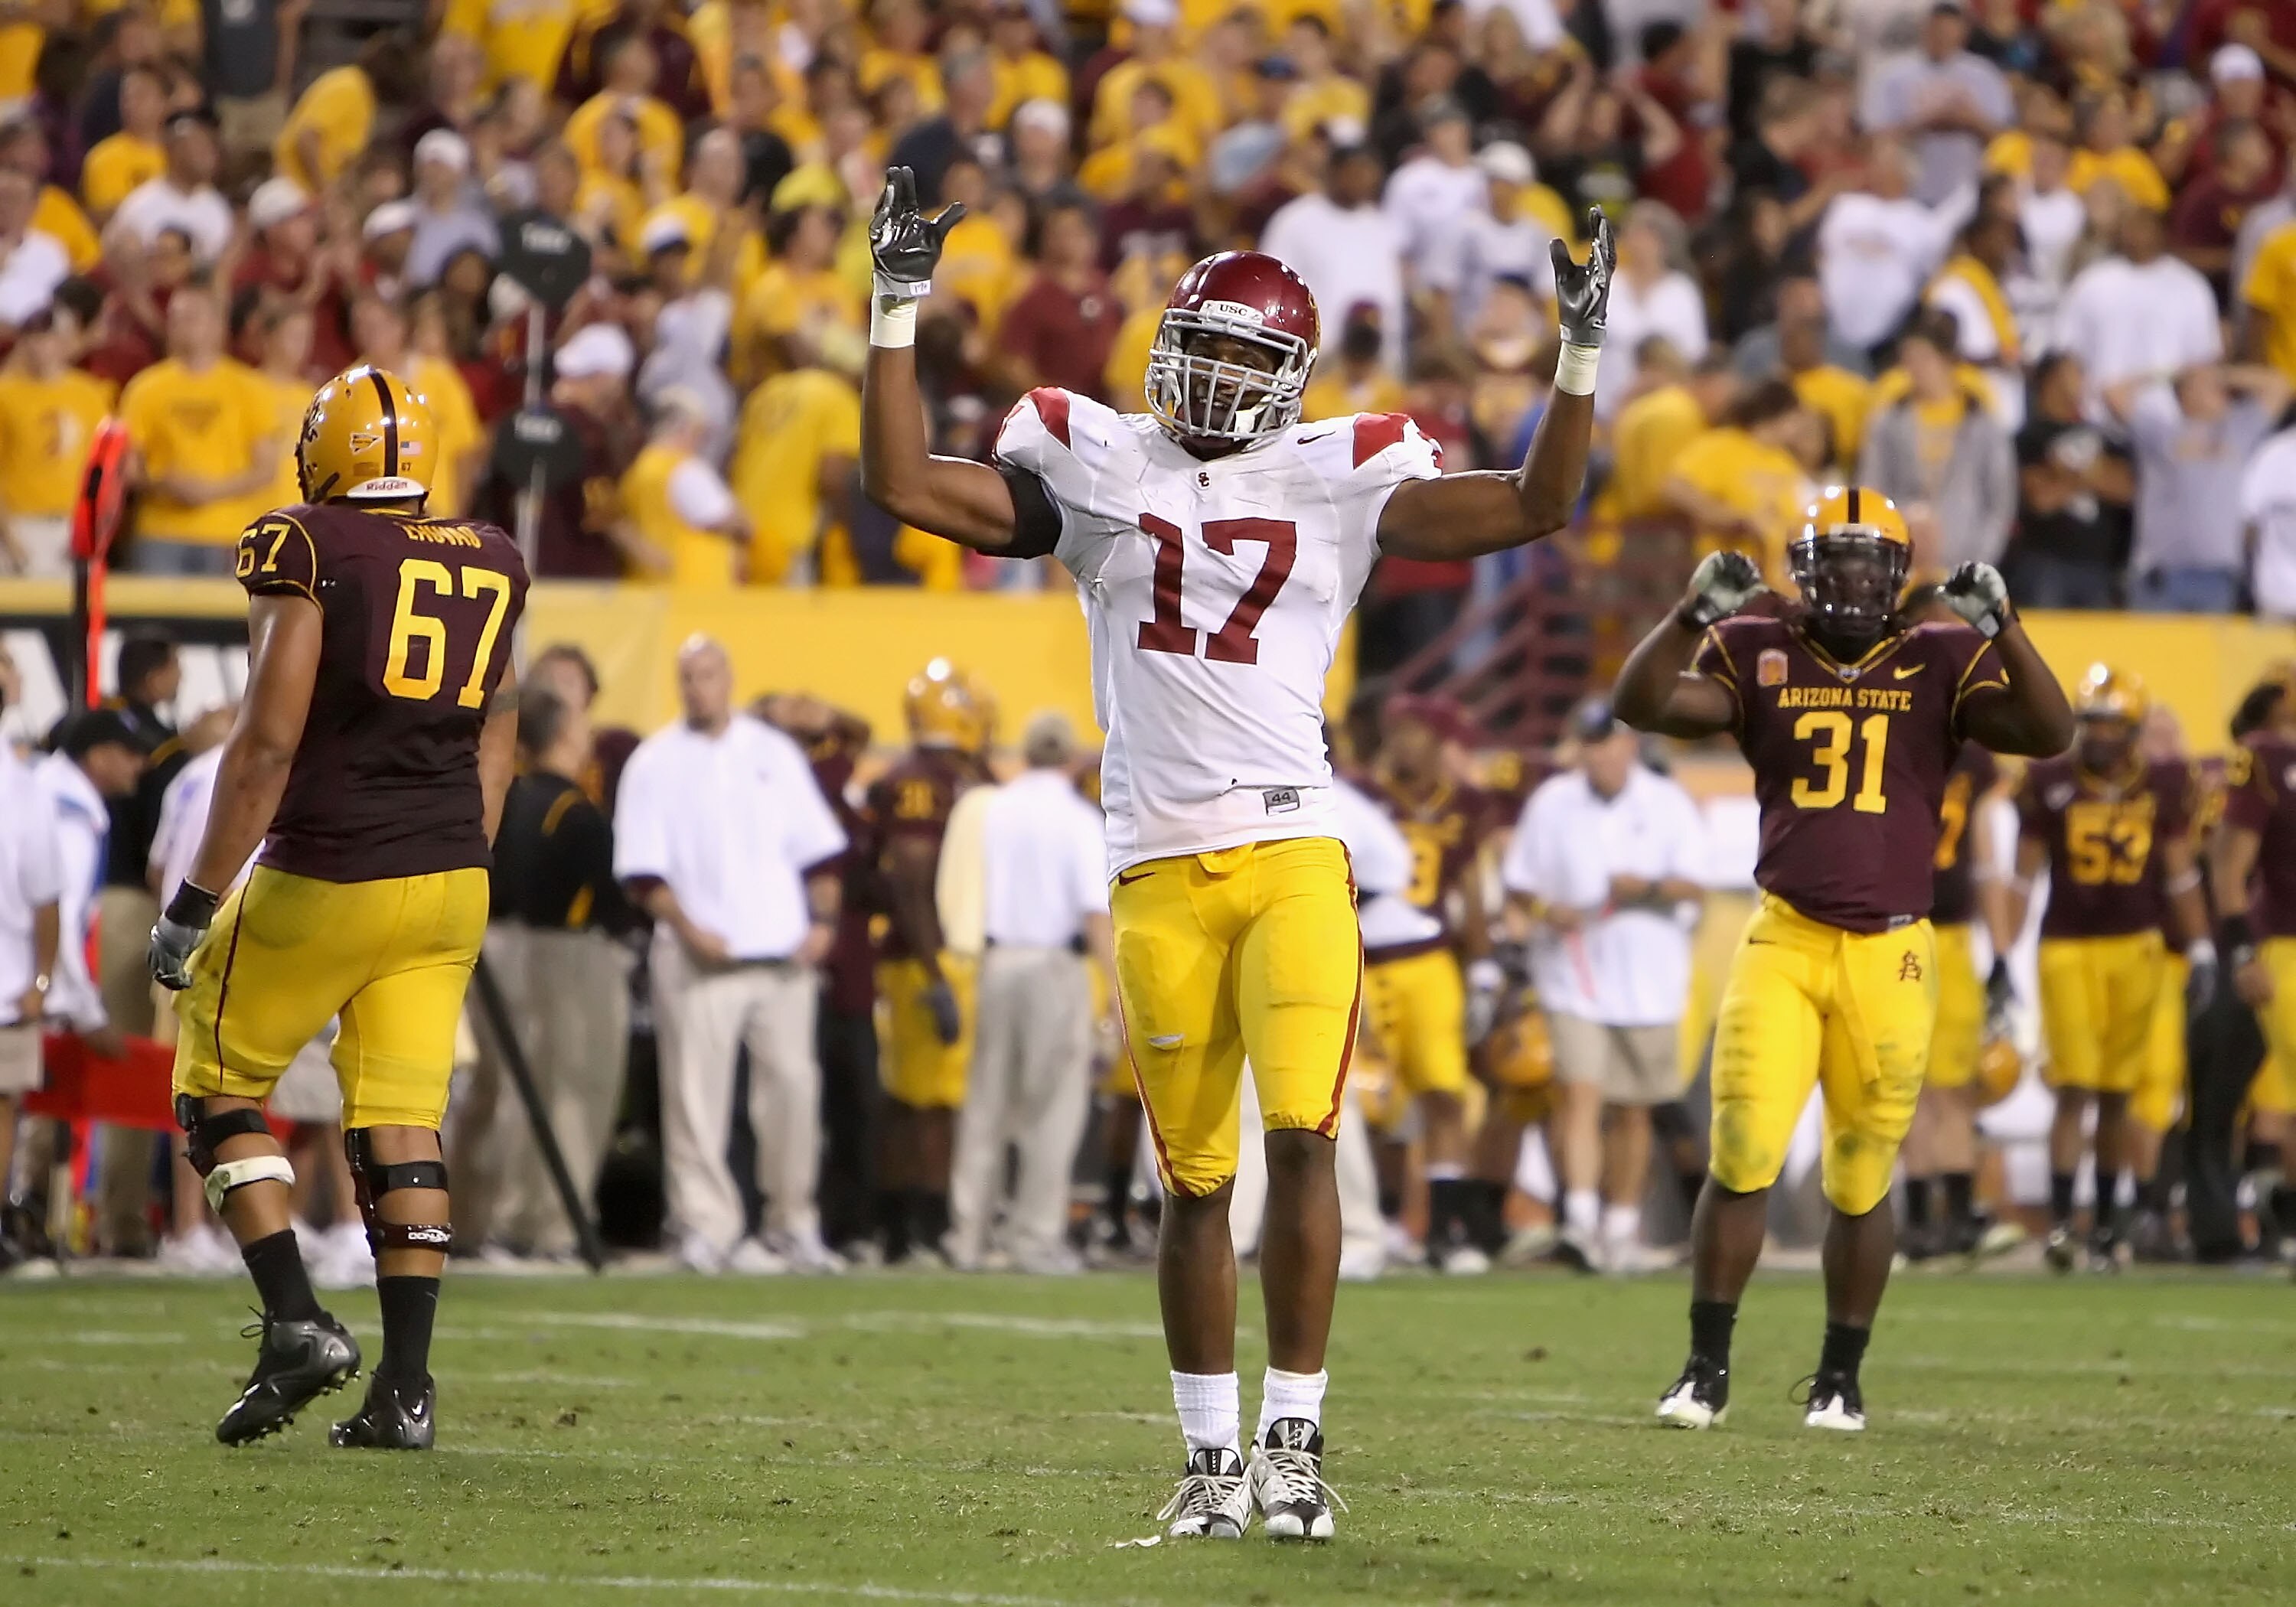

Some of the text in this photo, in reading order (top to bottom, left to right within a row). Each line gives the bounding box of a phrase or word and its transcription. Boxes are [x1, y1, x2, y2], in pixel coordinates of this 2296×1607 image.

[1219, 304, 1247, 316] USC
[400, 462, 411, 471] 67
[235, 523, 291, 579] 67
[1137, 512, 1297, 666] 17
[383, 558, 511, 710] 67
[1777, 687, 1913, 712] ARIZONA STATE
[1790, 710, 1890, 815] 31
[1272, 792, 1290, 804] 44
